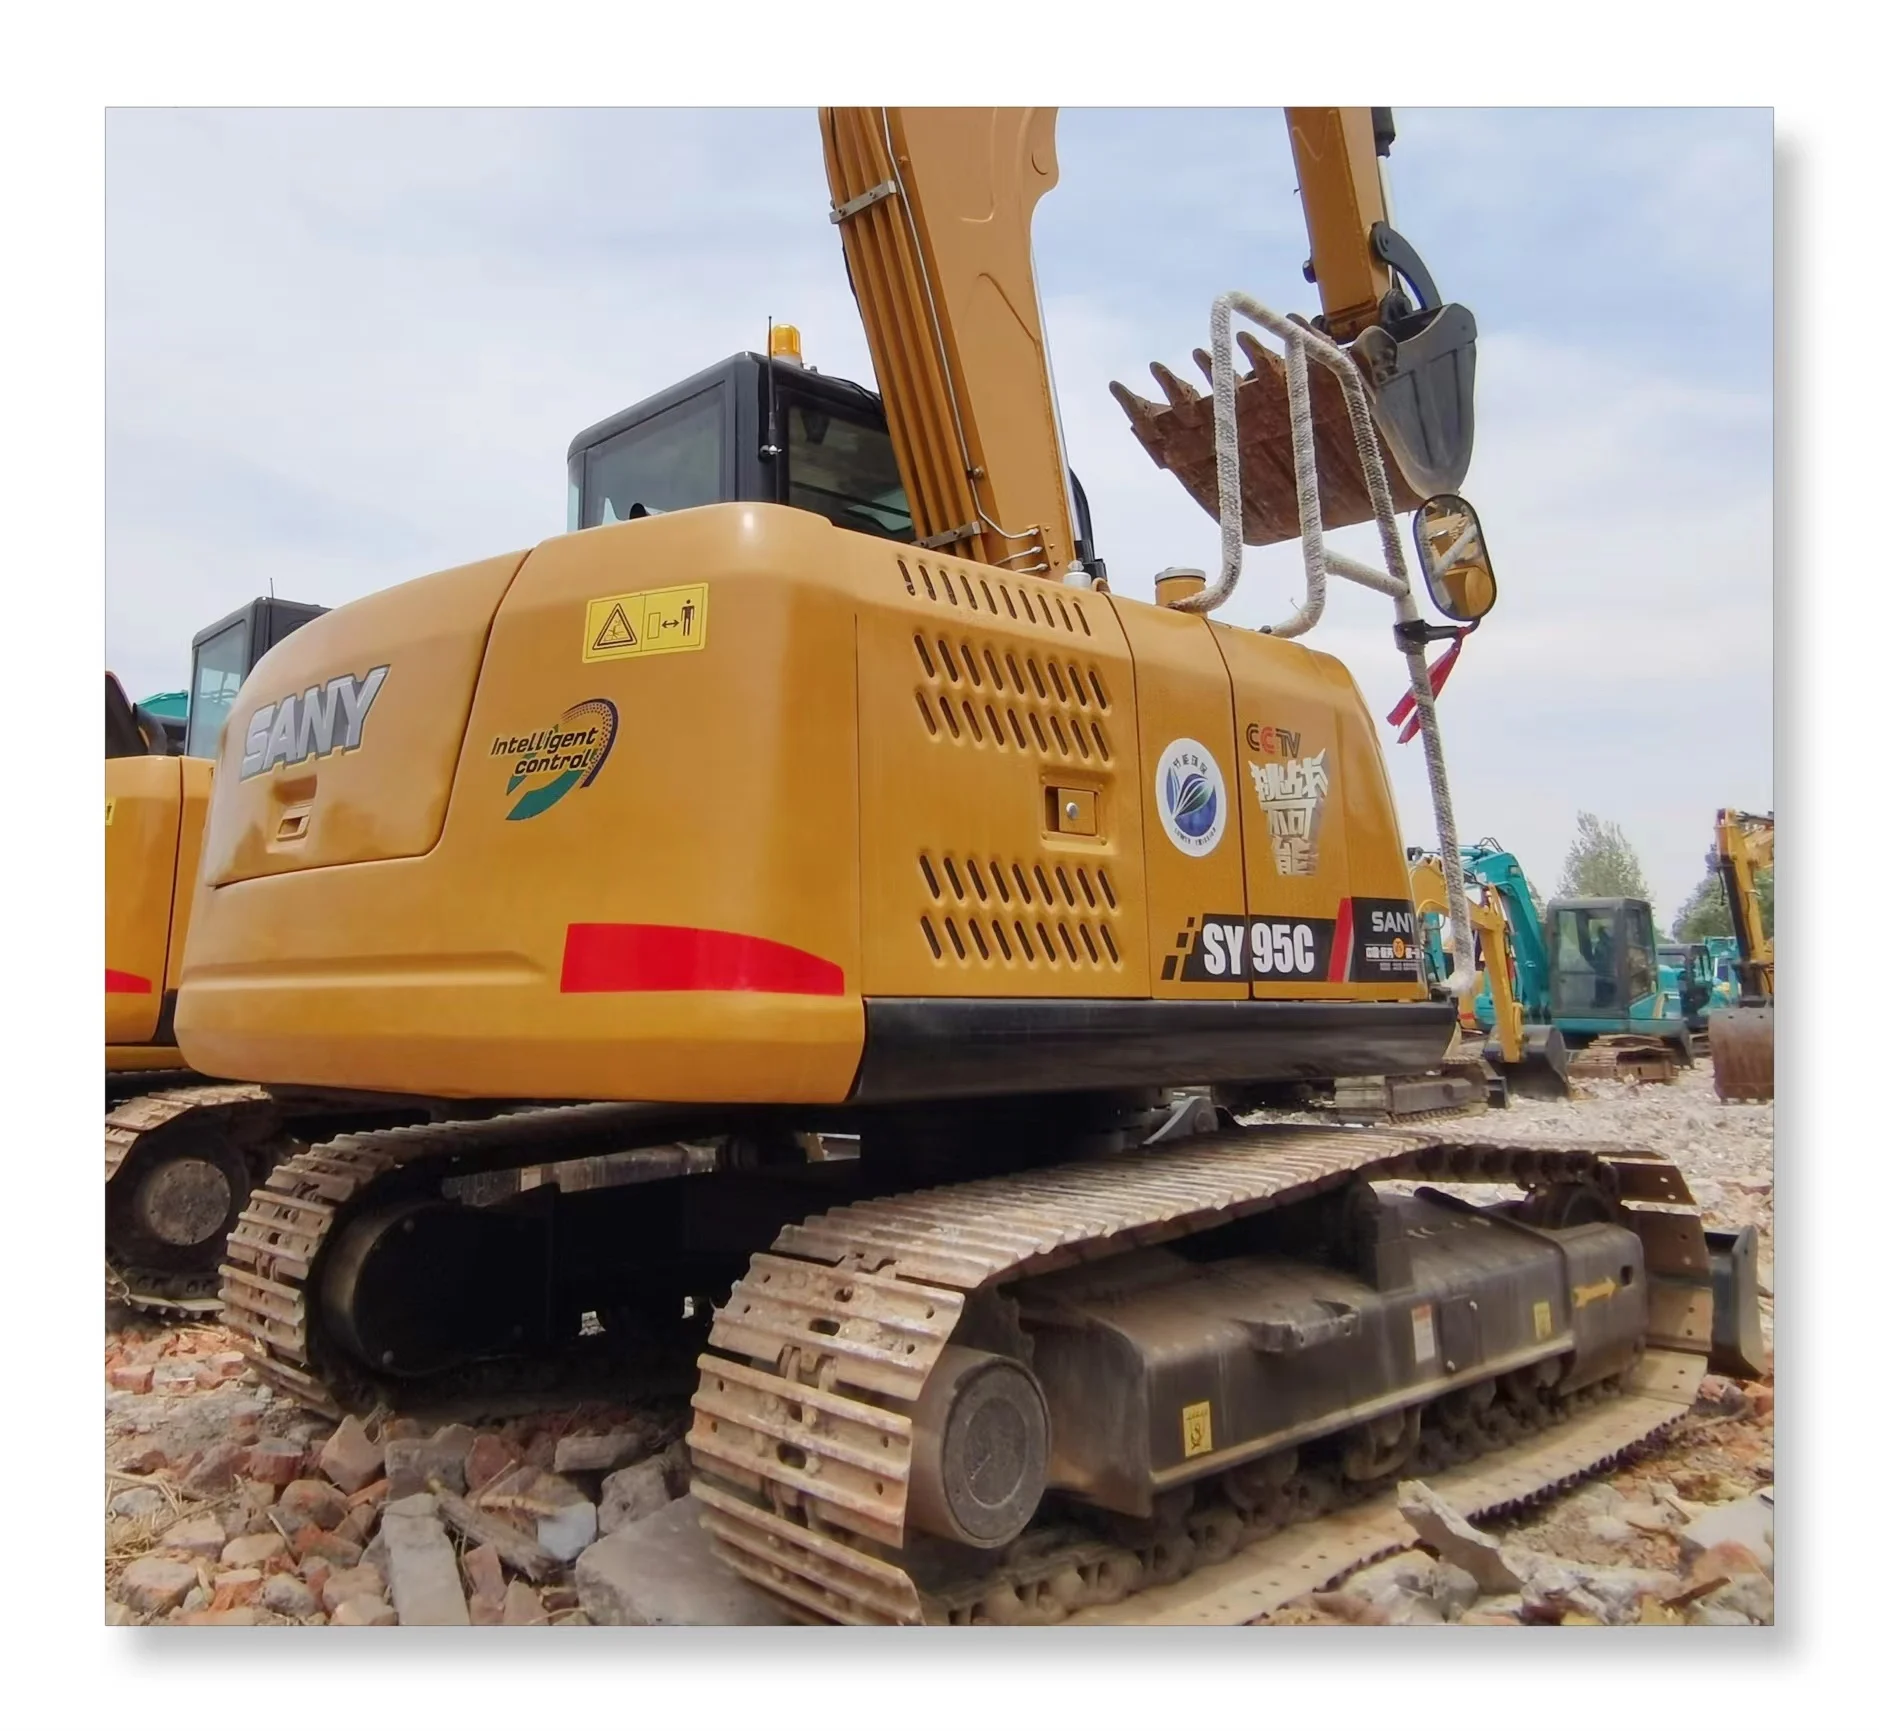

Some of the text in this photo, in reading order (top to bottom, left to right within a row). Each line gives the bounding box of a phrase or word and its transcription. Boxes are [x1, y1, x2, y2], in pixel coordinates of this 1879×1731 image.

[241, 665, 390, 781] SANY
[490, 727, 599, 756] Intelligent
[1246, 723, 1301, 758] CCTV
[514, 750, 592, 775] control
